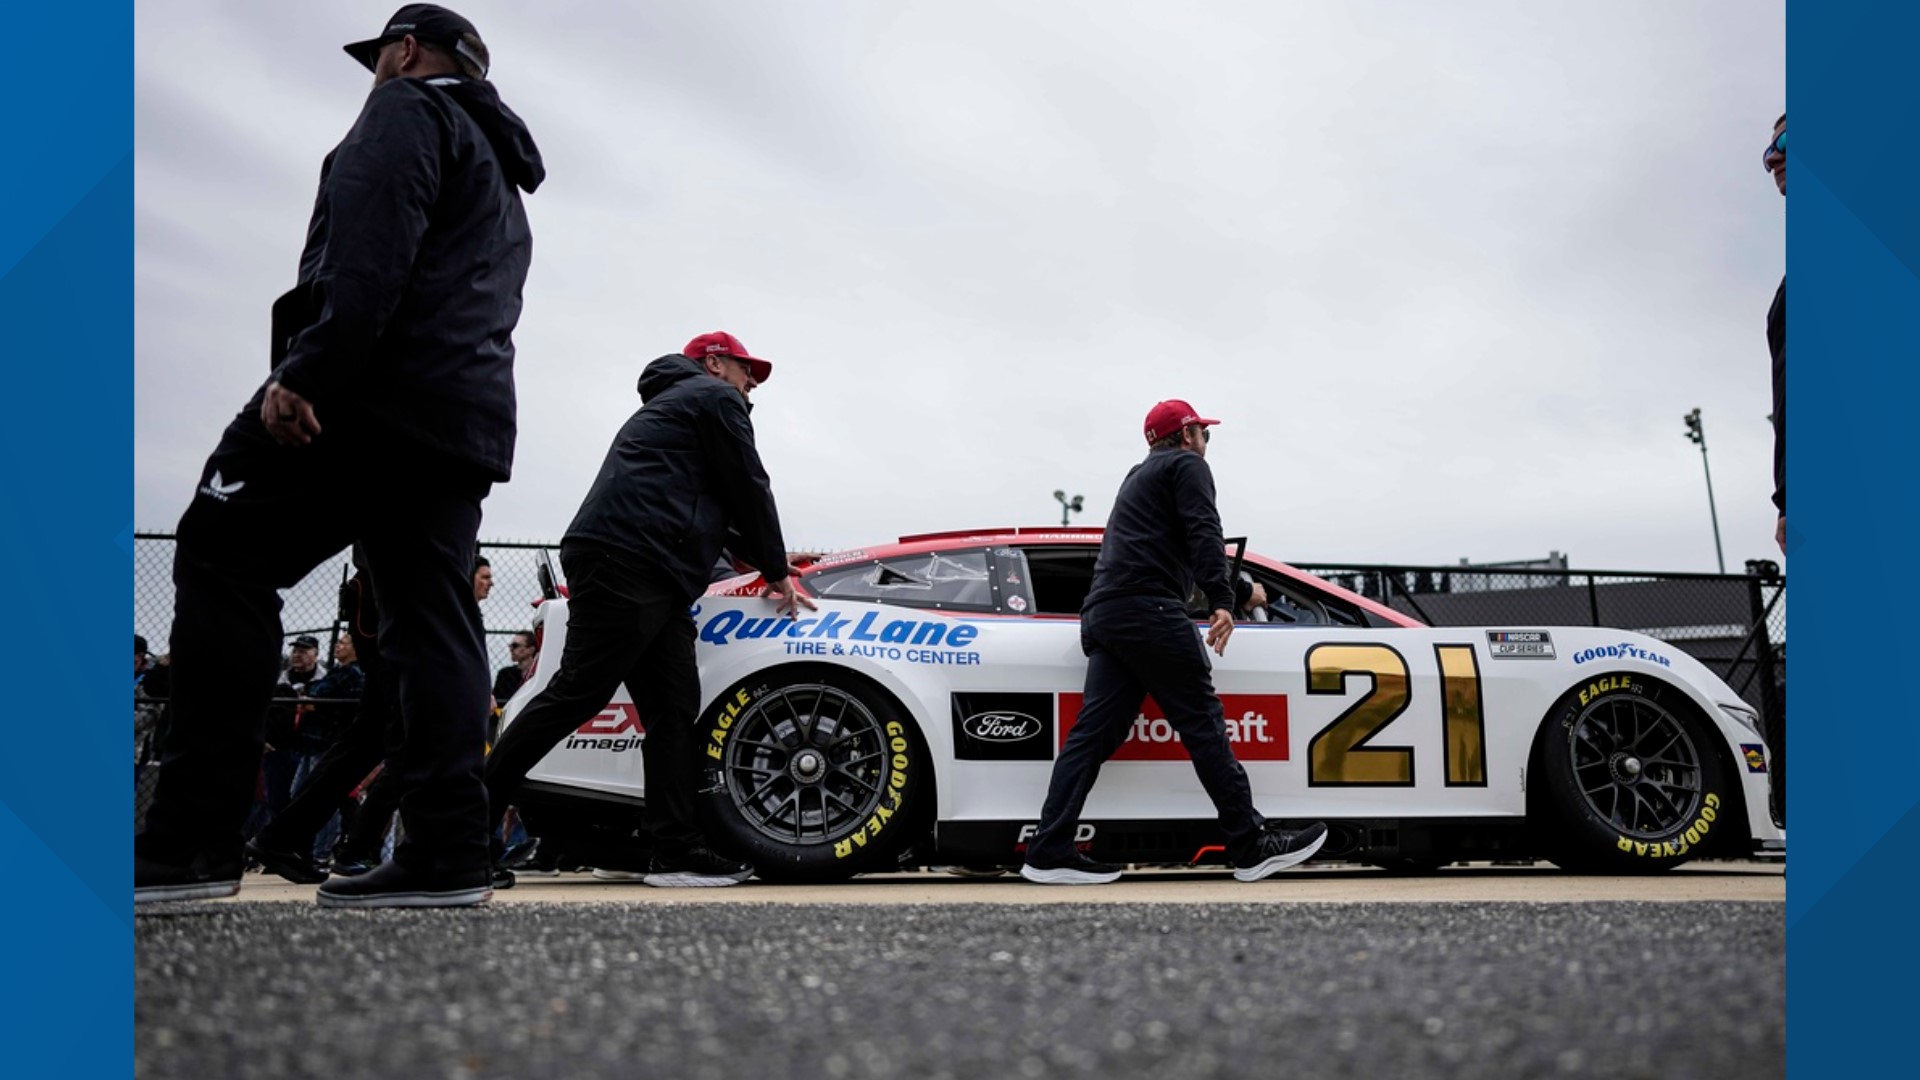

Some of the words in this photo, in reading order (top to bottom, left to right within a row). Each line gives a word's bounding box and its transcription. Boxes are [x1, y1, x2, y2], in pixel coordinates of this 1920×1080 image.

[700, 610, 853, 645] Quick
[848, 611, 979, 648] Lane
[1507, 633, 1541, 642] NASCAR
[784, 641, 827, 656] TIRE
[832, 643, 846, 656] &
[850, 644, 901, 660] AUTO
[906, 648, 980, 665] CENTER
[1500, 644, 1516, 653] CUP
[1517, 644, 1545, 653] SERIES
[1573, 642, 1671, 668] GOODYEAR
[1578, 676, 1631, 707] EAGLE
[577, 703, 646, 734] EX
[707, 687, 751, 760] EAGLE
[977, 714, 1028, 736] Ford
[1124, 711, 1268, 743] toaft
[1304, 642, 1488, 787] 21
[566, 735, 643, 752] imagi
[834, 720, 909, 858] GOODYEAR
[1017, 823, 1096, 843] FD
[1617, 792, 1720, 858] GOODYEAR
